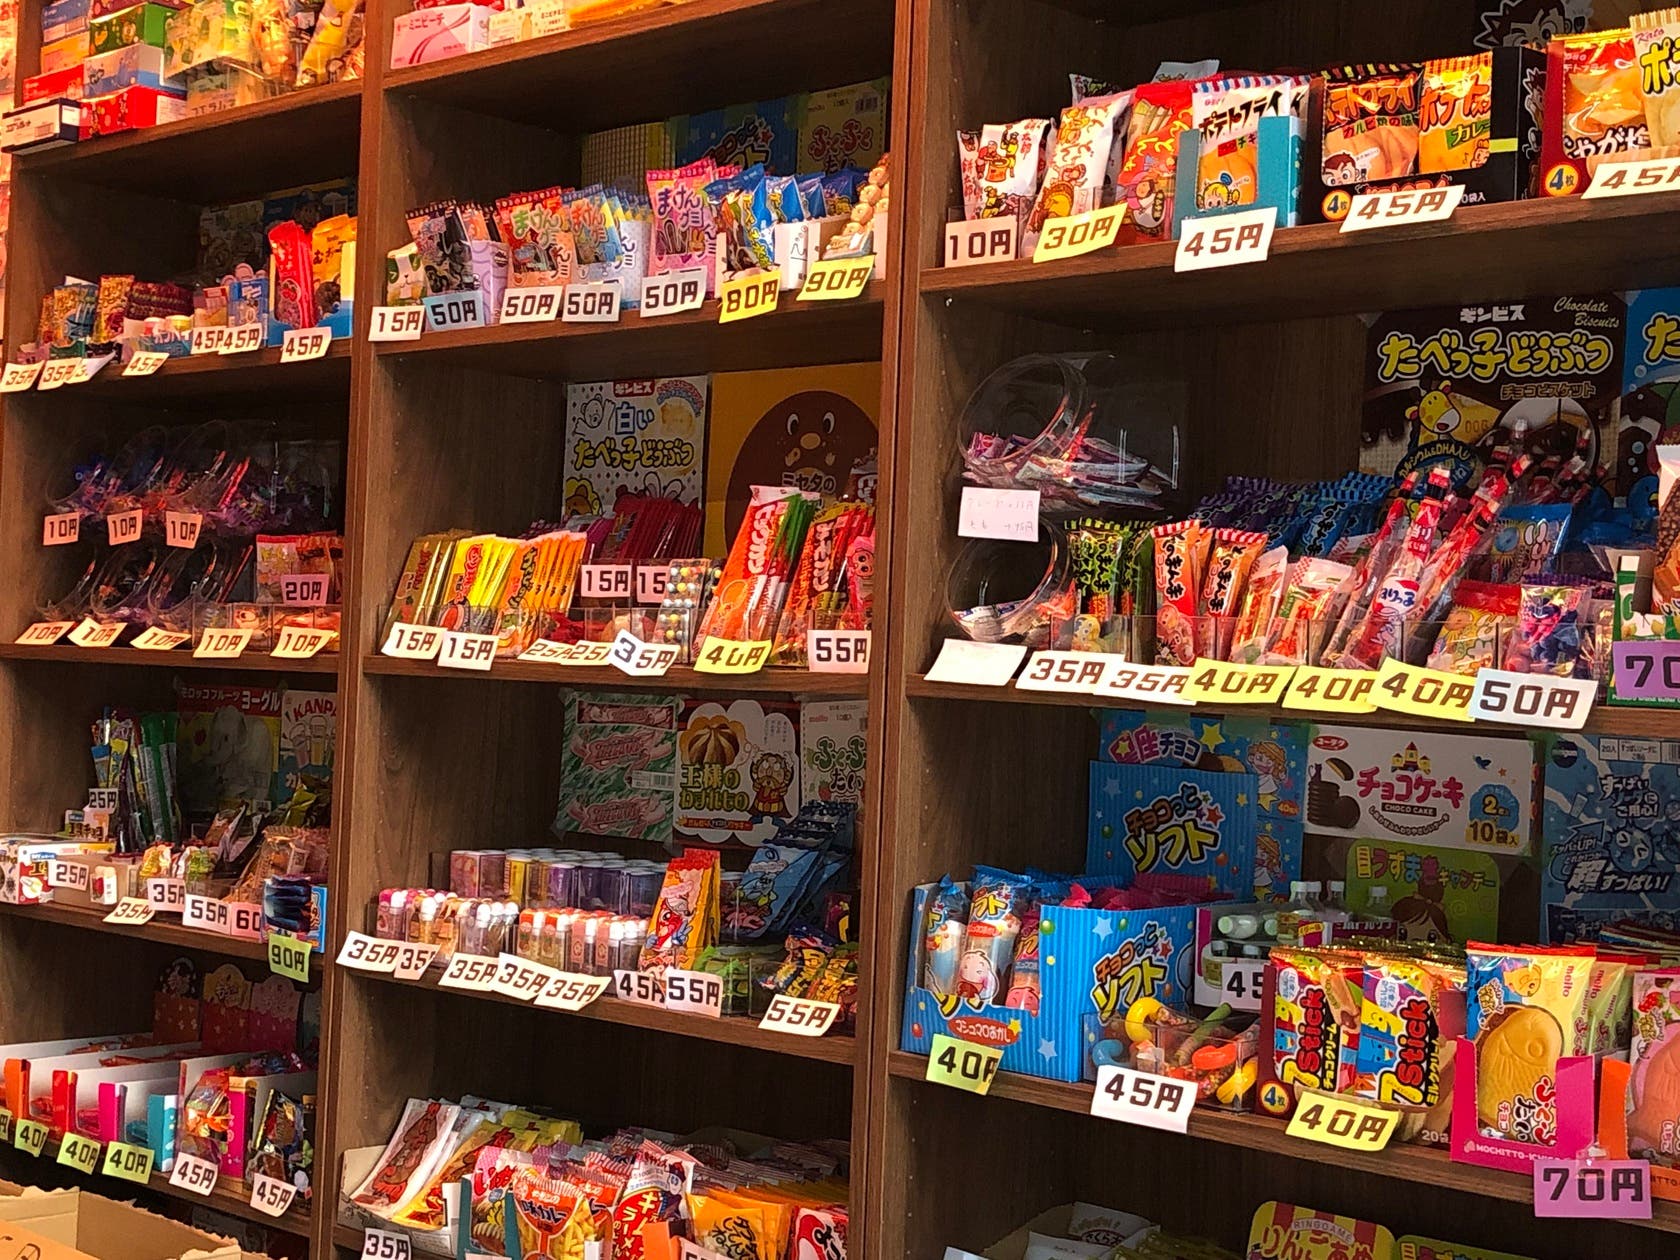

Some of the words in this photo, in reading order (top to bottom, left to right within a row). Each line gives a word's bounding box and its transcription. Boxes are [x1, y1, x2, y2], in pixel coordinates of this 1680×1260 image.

[1640, 38, 1680, 97] ポ
[1548, 167, 1574, 191] 4枚
[656, 186, 701, 215] まけん
[1356, 187, 1446, 219] 45円
[513, 205, 563, 238] まけん
[1043, 214, 1114, 250] 30円
[949, 228, 1011, 260] 10円
[1183, 221, 1265, 259] 45円
[805, 268, 869, 292] 90円
[505, 295, 556, 317] 50円
[567, 293, 613, 315] 50円
[645, 280, 698, 308] 50円
[726, 282, 778, 313] 80円
[1554, 297, 1608, 315] Chocolate
[378, 311, 420, 333] 15円
[431, 300, 477, 325] 50円
[1460, 305, 1526, 323] ギンビス
[1574, 312, 1620, 330] Biscuits
[224, 328, 258, 348] 45円
[285, 335, 321, 356] 45円
[128, 356, 158, 373] 45円
[1379, 330, 1613, 381] たべっ子どうぶつ
[6, 369, 37, 386] 35円
[615, 382, 654, 395] ギンビス
[1501, 384, 1597, 399] チョコビスケット
[615, 402, 655, 435] 白い
[573, 436, 695, 472] たべっ子どうぶつ
[49, 518, 77, 537] 10円
[111, 517, 137, 536] 10円
[171, 521, 198, 540] 10円
[285, 580, 322, 601] 20円
[585, 569, 630, 592] 15円
[28, 626, 67, 641] 10円
[88, 624, 120, 642] 10円
[143, 633, 182, 647] 10円
[206, 635, 241, 651] 10円
[282, 634, 321, 652] 10円
[397, 628, 437, 652] 15円
[447, 636, 494, 661] 15円
[569, 644, 611, 660] 25
[614, 637, 671, 669] 35円
[705, 644, 766, 667] 40円
[815, 637, 867, 663] 55円
[1029, 658, 1104, 684] 35円
[1110, 669, 1188, 694] 35円
[1193, 668, 1280, 694] 40円
[241, 690, 281, 712] ヨーグル
[1381, 672, 1475, 708] 40円
[1478, 679, 1581, 719] 50円
[814, 735, 867, 771] ふくふ
[680, 763, 742, 790] 王様の
[1356, 765, 1465, 809] チョコケーキ
[1600, 775, 1650, 800] すっぱい
[89, 790, 117, 809] 25円
[1125, 782, 1202, 836] チョコっと
[1384, 805, 1411, 815] CHOCO
[1412, 807, 1435, 817] CAKE
[1126, 821, 1220, 873] ソフト
[56, 864, 87, 886] 25円
[1567, 860, 1669, 893] 超すっぱい!
[114, 902, 151, 919] 35円
[190, 900, 227, 925] 55円
[271, 944, 305, 973] 90円
[347, 939, 400, 964] 35円
[400, 948, 435, 971] 35
[1094, 926, 1161, 982] チョコっと
[449, 959, 499, 984] 35円
[500, 963, 550, 992] 35円
[546, 979, 601, 1002] 35円
[668, 975, 719, 1007] 55円
[1093, 960, 1168, 1021] ソフト
[767, 1000, 832, 1028] 55円
[1299, 986, 1325, 1075] Stick
[1397, 999, 1431, 1087] Stick
[1321, 1022, 1338, 1089] チョコクリーム
[1105, 1073, 1184, 1113] 45円
[1380, 1070, 1423, 1105] 7
[1299, 1103, 1389, 1142] 40円
[1533, 1077, 1557, 1146] ふくふ
[19, 1126, 46, 1148] 40
[109, 1152, 147, 1175] 40円
[177, 1162, 214, 1188] 45円
[256, 1181, 291, 1209] 45円
[1543, 1167, 1643, 1202] 70円
[1293, 1219, 1353, 1244] RINGOAME
